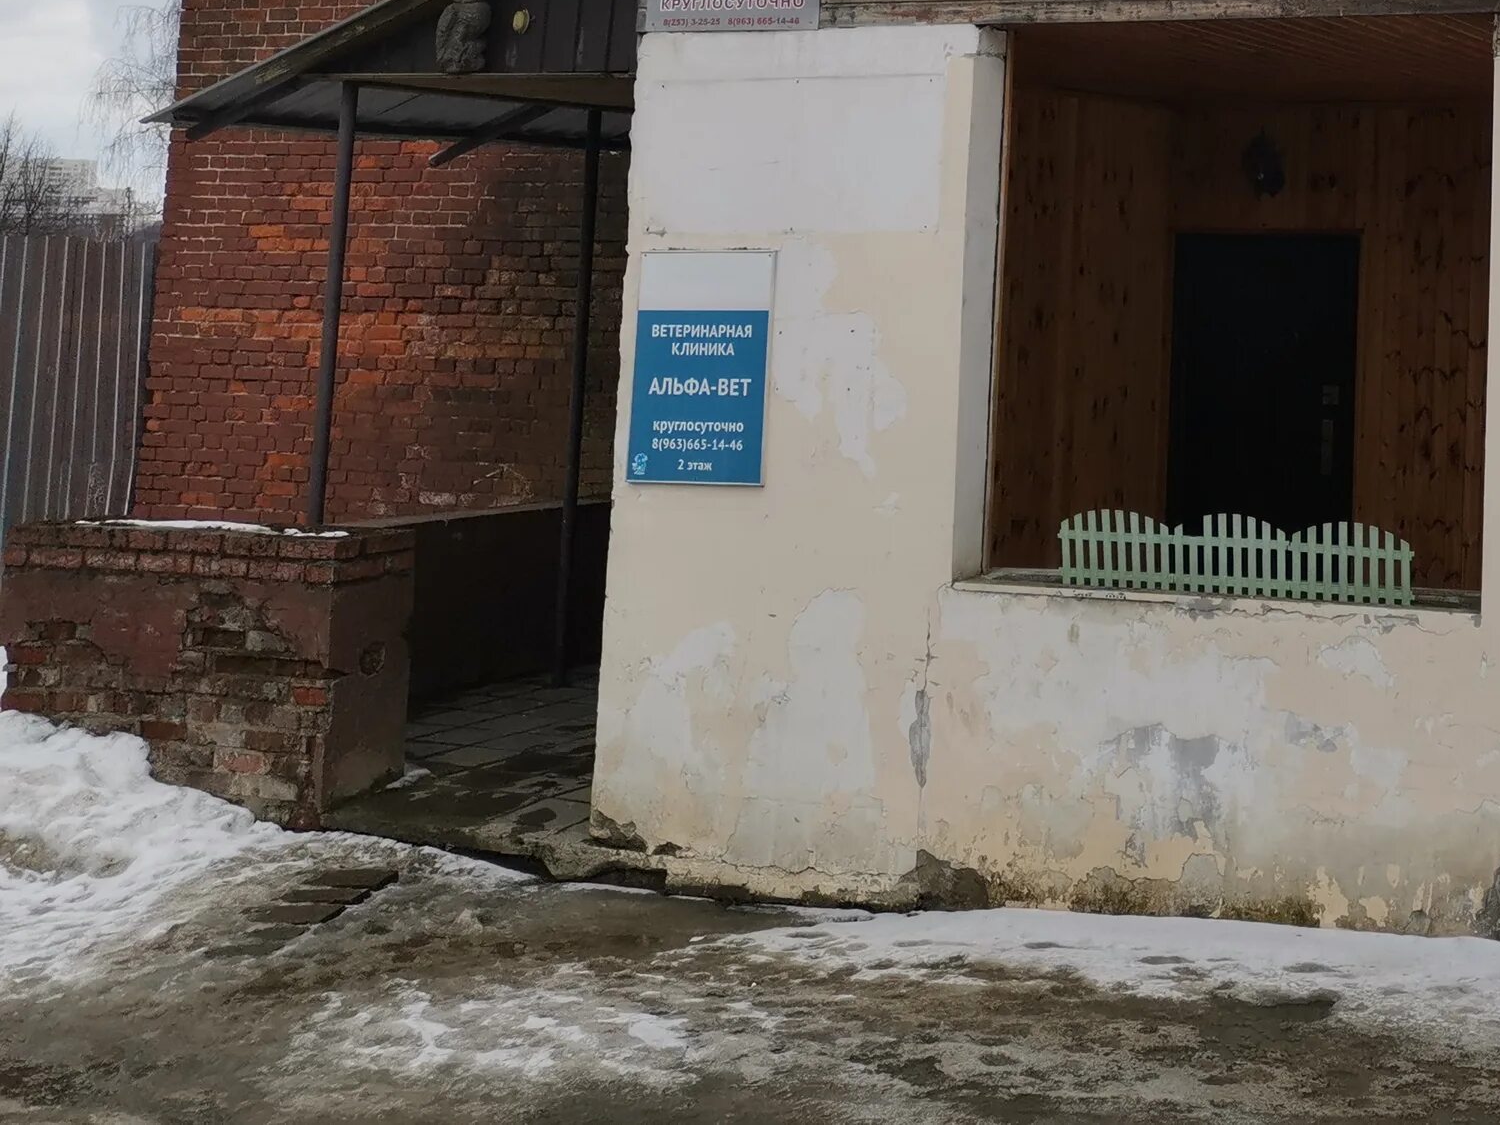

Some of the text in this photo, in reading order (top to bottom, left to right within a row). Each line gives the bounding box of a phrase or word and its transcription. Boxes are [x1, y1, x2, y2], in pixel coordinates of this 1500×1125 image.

[651, 324, 752, 338] ВЕТЕРИНАРНАЯ
[671, 342, 735, 356] КЛИНИКА
[648, 377, 752, 397] АЛЬФА-ВЕТ
[653, 419, 745, 435] круглосуточно
[652, 438, 744, 452] 8(963)665-14-46
[677, 458, 712, 471] 2 этаж
